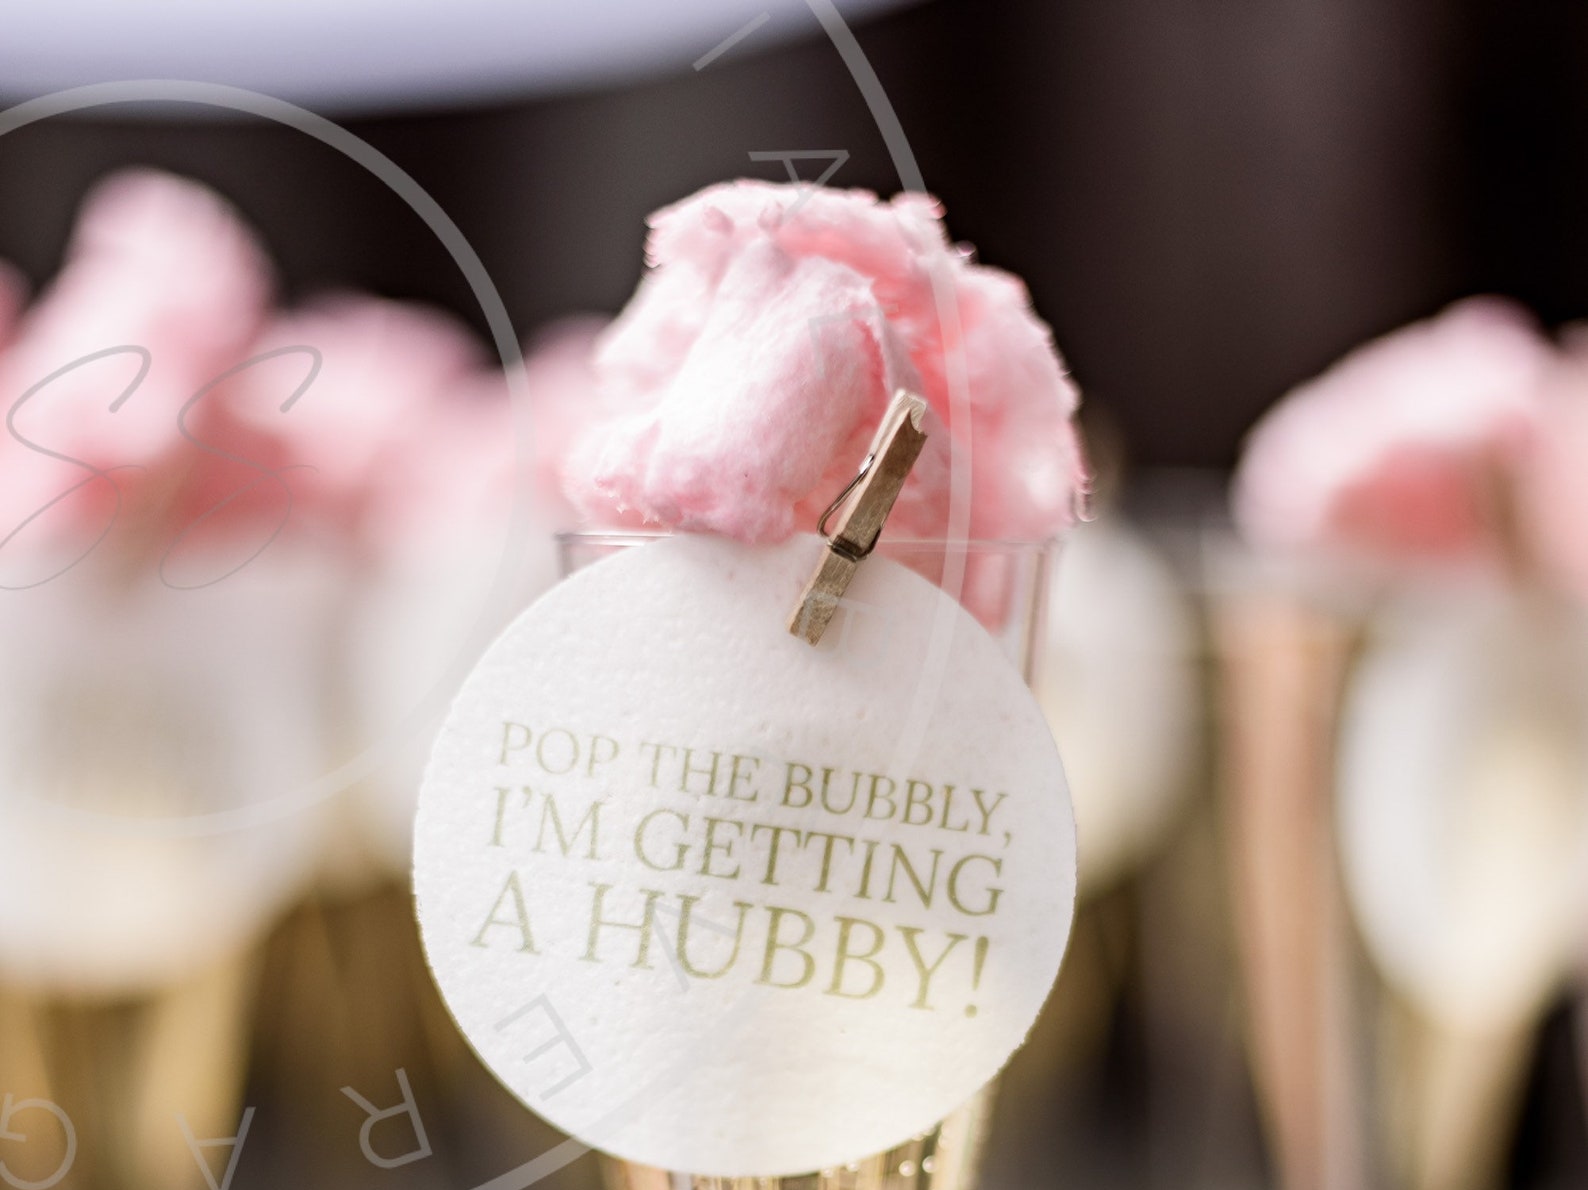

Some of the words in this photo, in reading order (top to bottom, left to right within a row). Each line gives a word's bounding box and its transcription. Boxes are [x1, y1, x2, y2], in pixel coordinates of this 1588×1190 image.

[500, 721, 620, 777] POP
[640, 741, 761, 802] THE
[779, 760, 1014, 846] BUBBLY,
[486, 785, 607, 861] I'M
[633, 808, 1007, 917] GETTING
[469, 870, 541, 956] A
[577, 881, 991, 1020] HUBBY!
